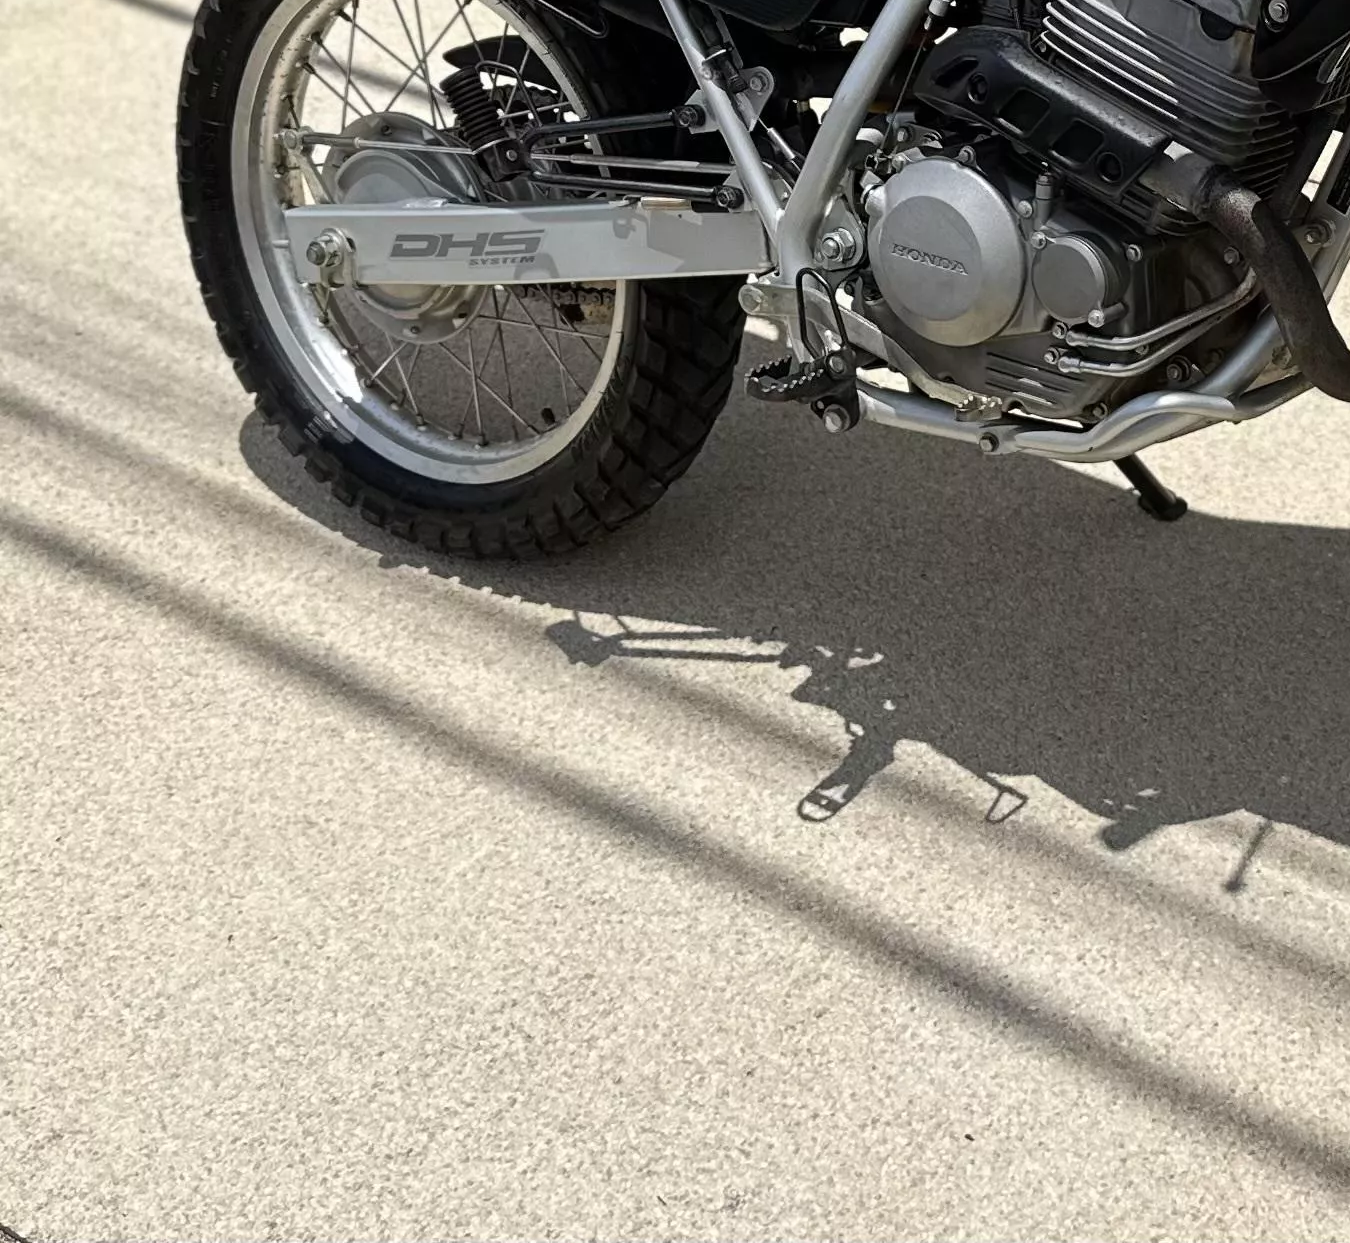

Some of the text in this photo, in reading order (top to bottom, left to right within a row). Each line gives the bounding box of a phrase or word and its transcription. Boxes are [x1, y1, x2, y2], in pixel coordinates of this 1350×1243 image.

[390, 229, 545, 257] DHS
[469, 256, 536, 267] SYSTEM
[891, 243, 968, 276] HONDA
